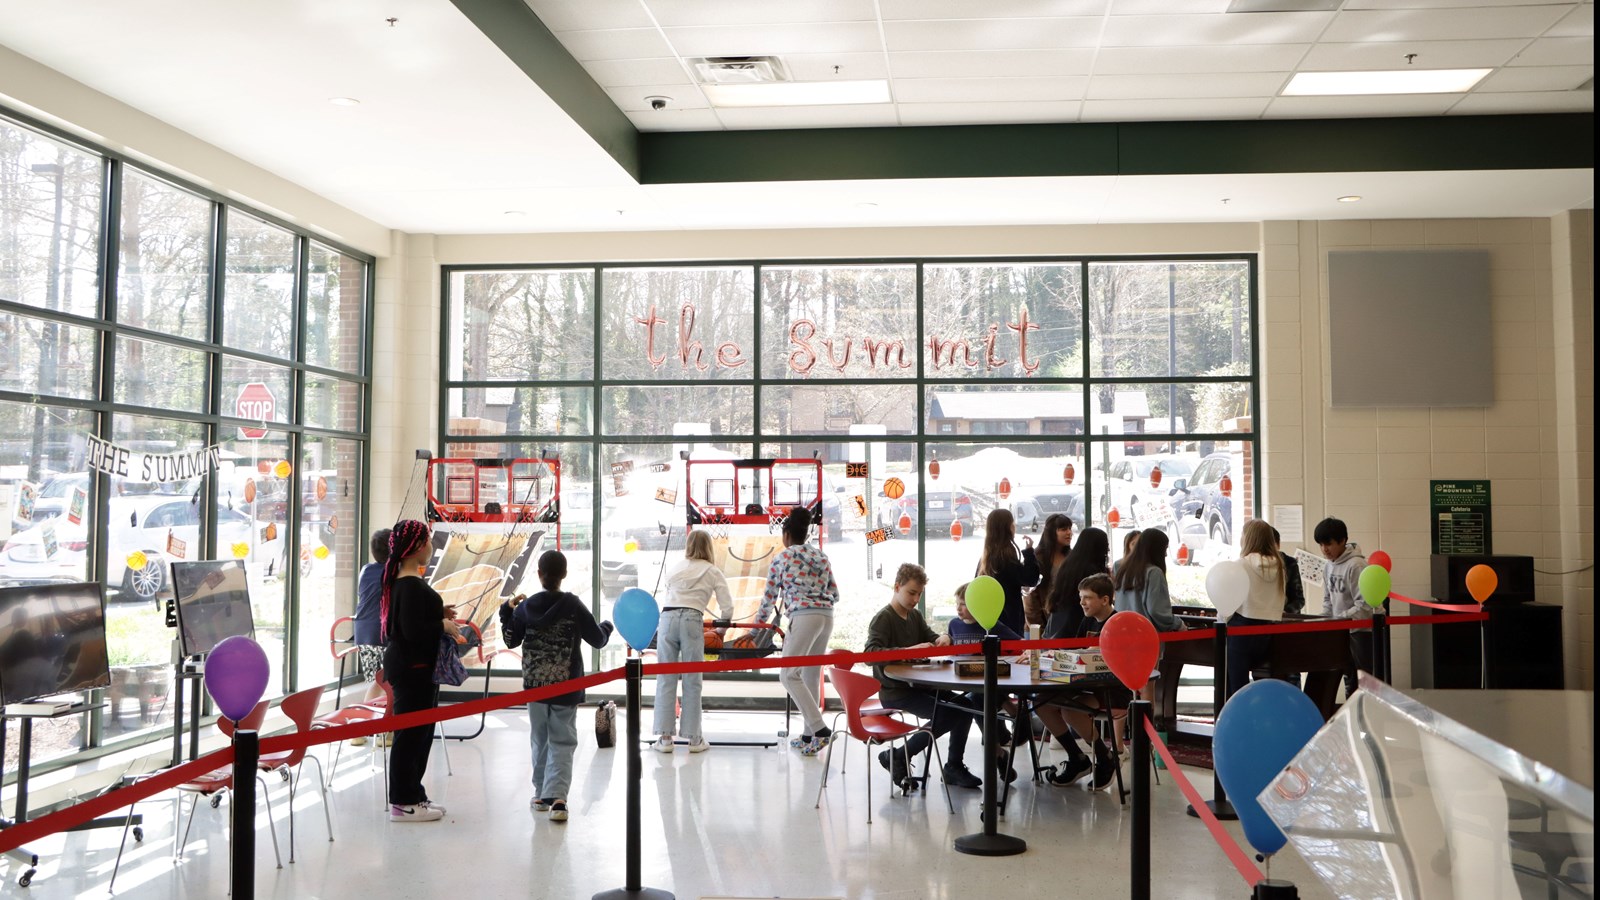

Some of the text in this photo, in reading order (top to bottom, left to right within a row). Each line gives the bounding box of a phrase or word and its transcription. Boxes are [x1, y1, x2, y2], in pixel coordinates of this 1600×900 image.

[634, 303, 746, 371] the
[240, 401, 272, 421] STOP
[88, 437, 220, 482] THE SUMMIT
